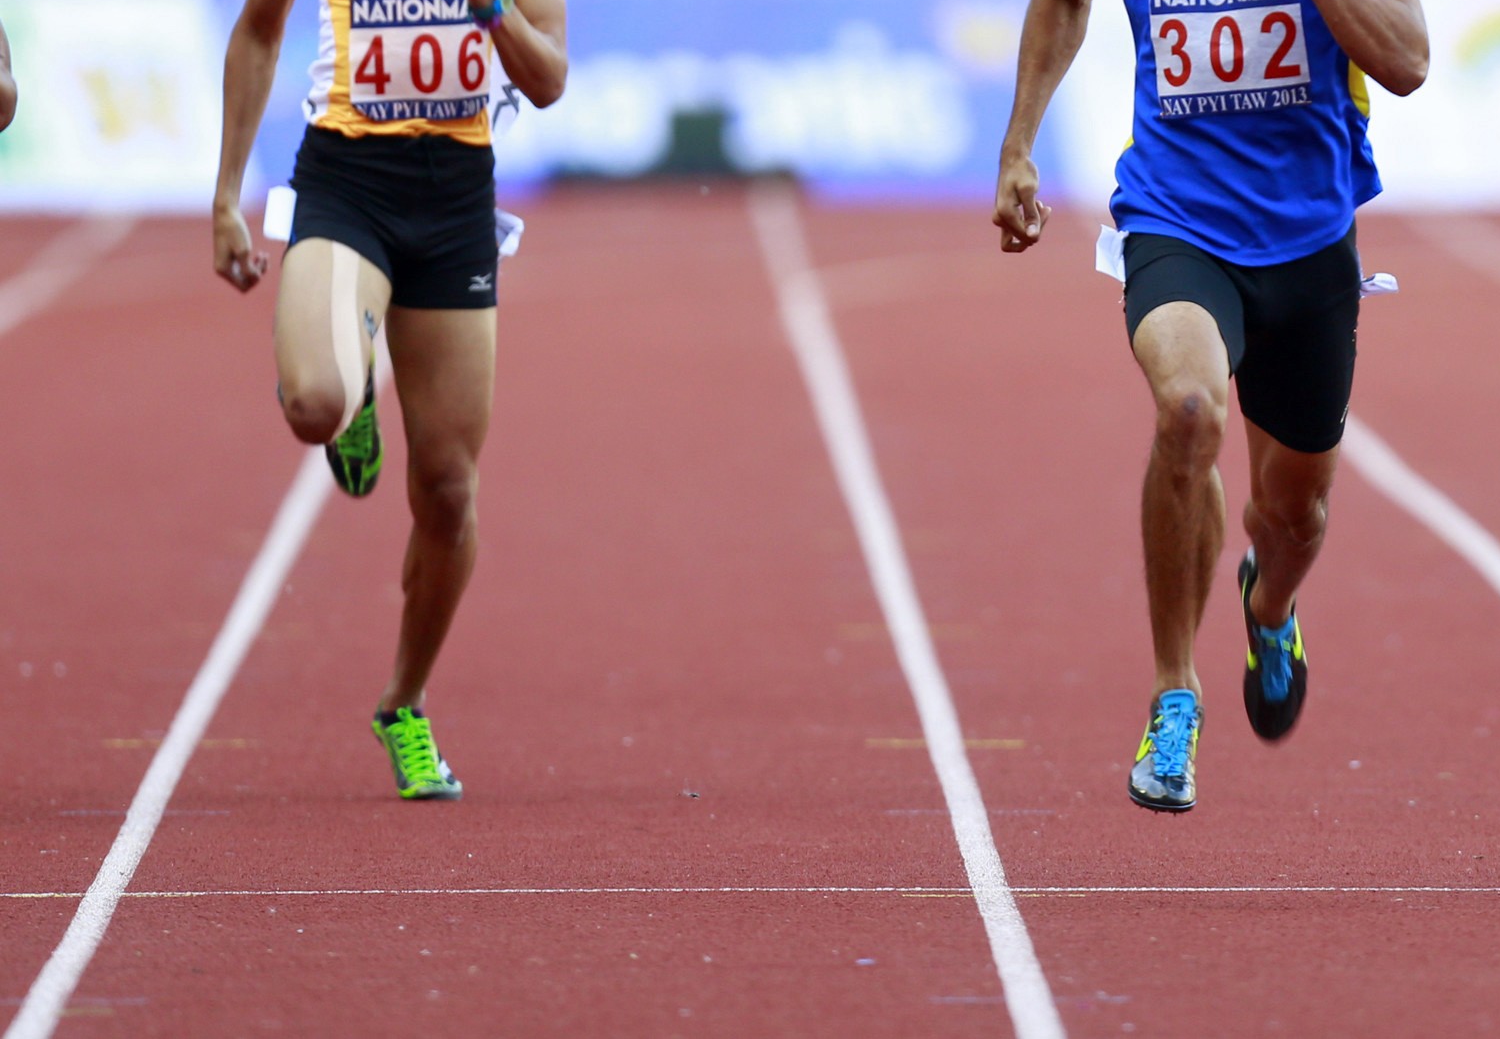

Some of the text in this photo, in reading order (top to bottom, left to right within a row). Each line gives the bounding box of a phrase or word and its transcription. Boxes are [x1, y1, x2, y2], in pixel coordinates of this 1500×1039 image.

[354, 29, 486, 95] 406
[1158, 11, 1302, 87] 302
[393, 102, 420, 120] PYI
[426, 101, 457, 119] TAW
[1163, 86, 1308, 116] NAY PYI TAW 2013
